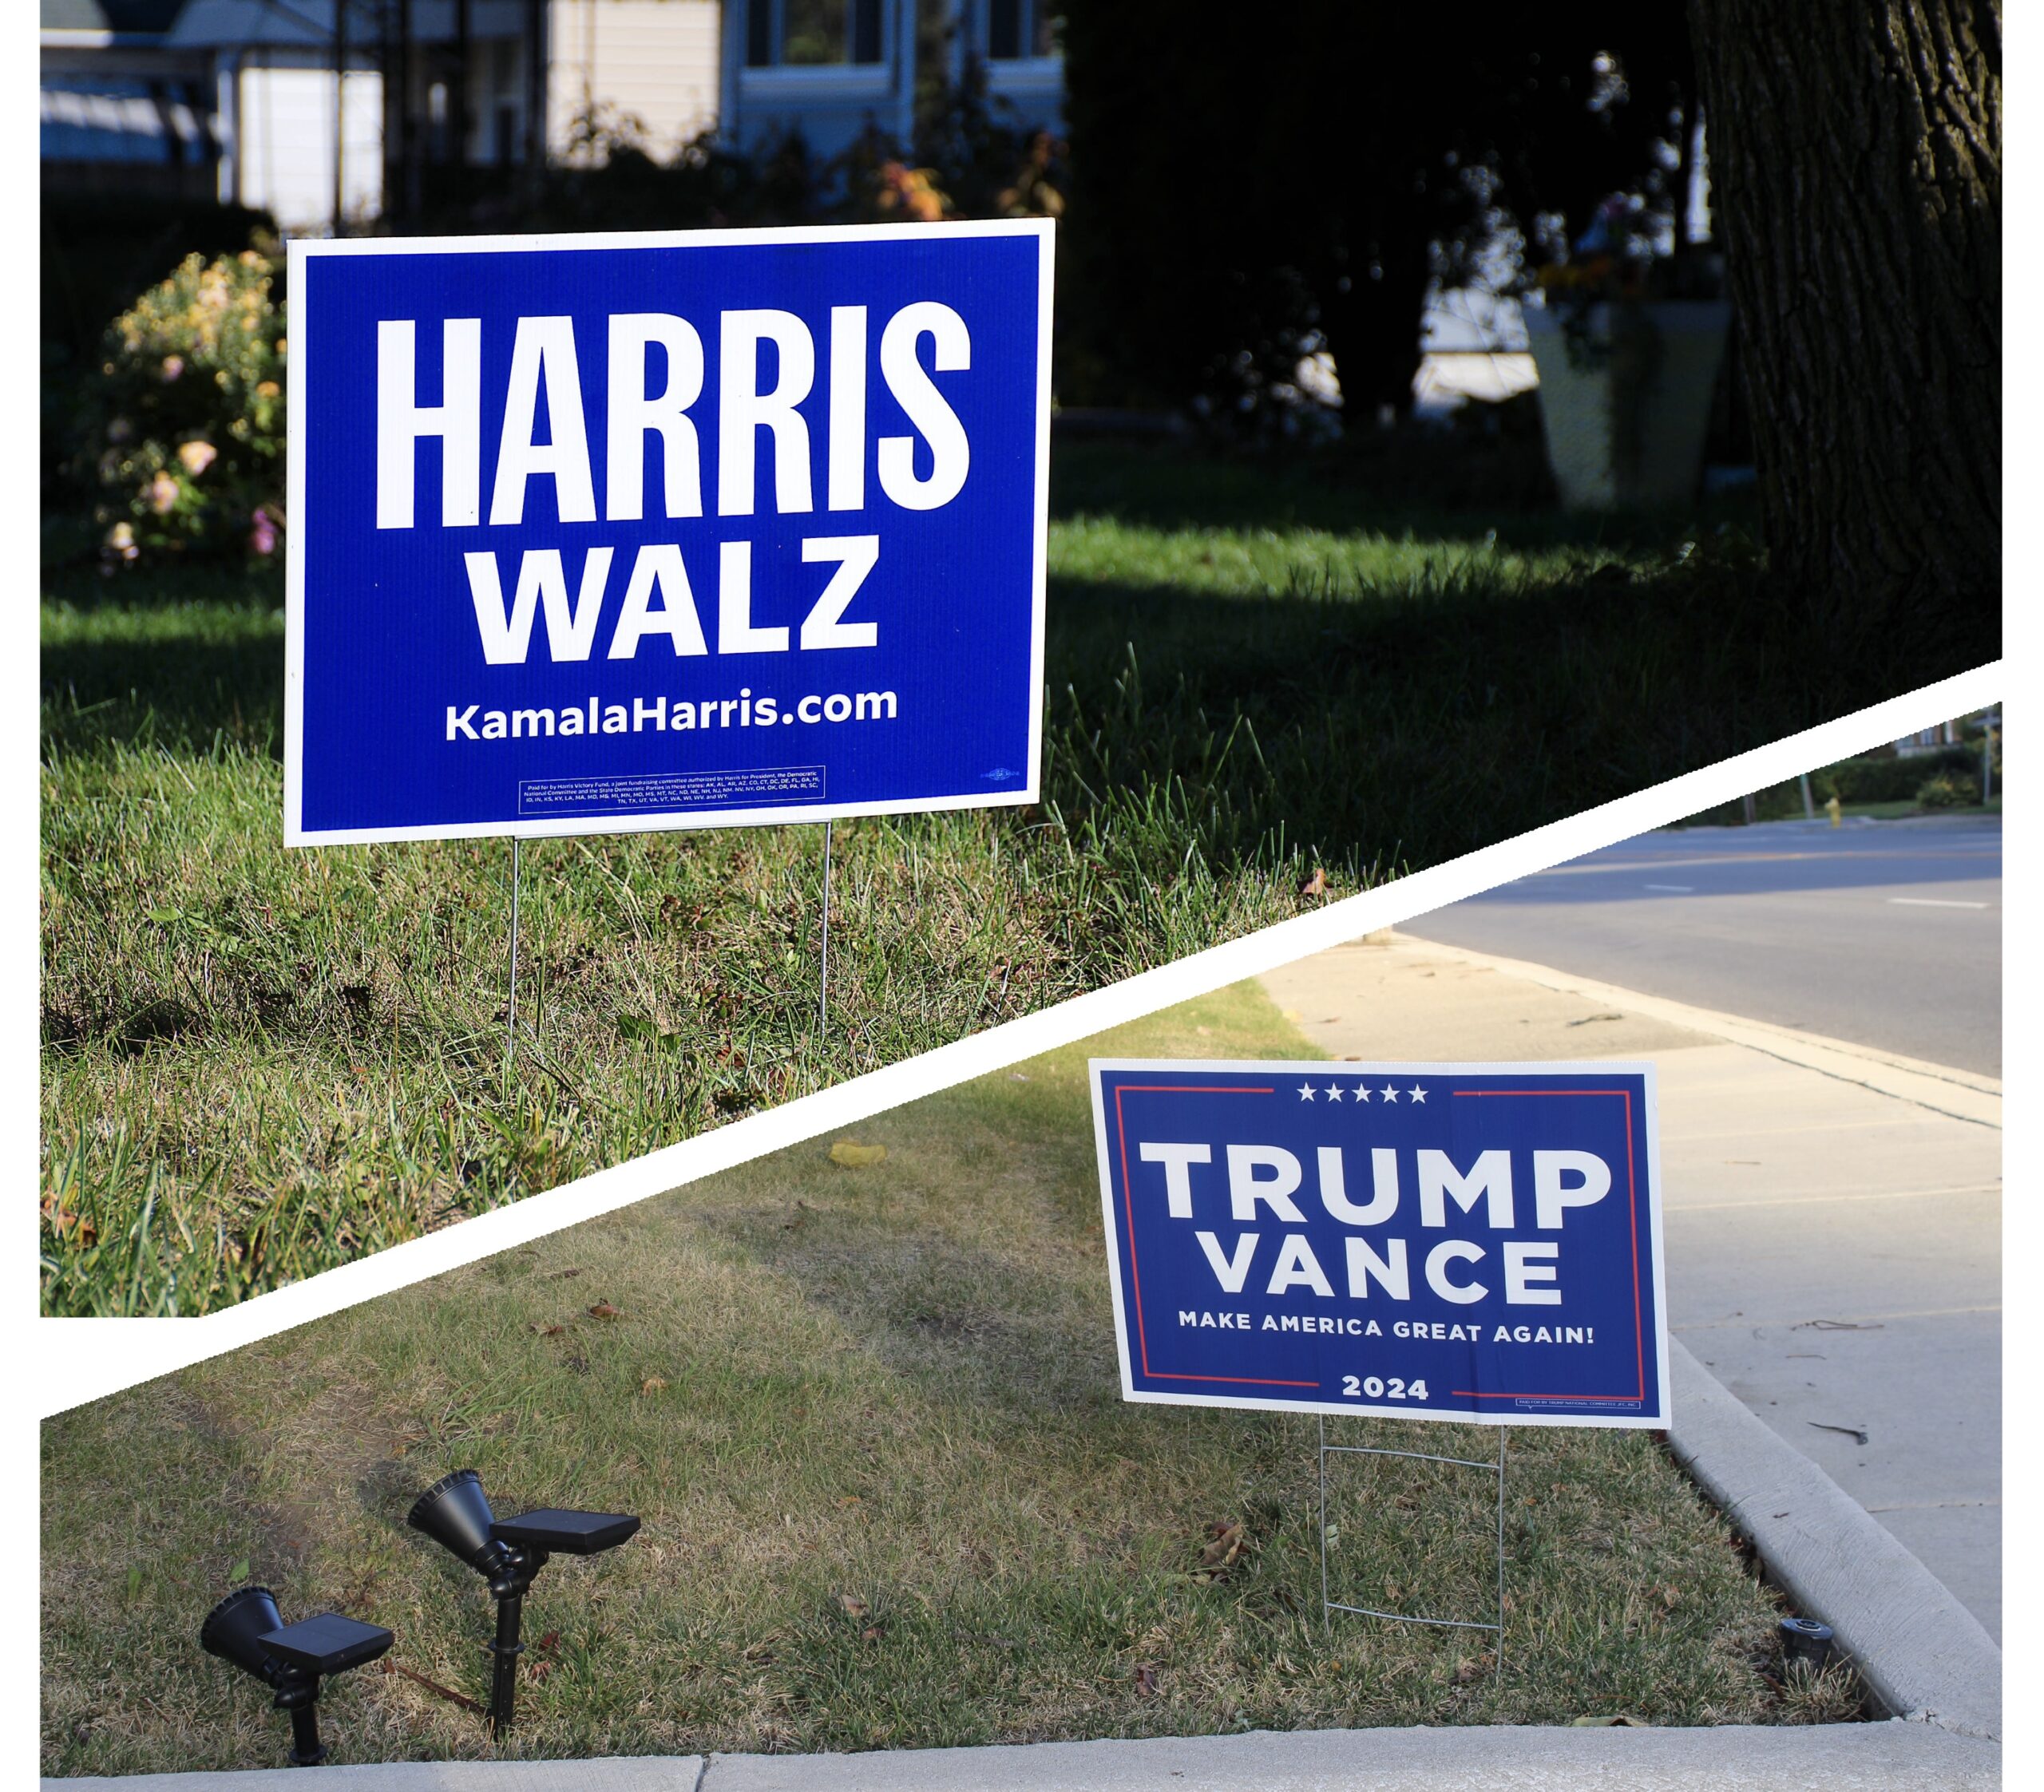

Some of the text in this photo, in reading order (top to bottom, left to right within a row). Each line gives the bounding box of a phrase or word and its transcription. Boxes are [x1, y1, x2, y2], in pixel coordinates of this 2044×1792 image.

[377, 302, 970, 528] HARRIS
[464, 535, 879, 664] WALZ
[446, 688, 897, 741] KamalaHarris.com
[1140, 1142, 1610, 1228] TRUMP
[1195, 1232, 1561, 1304] VANCE
[1179, 1311, 1594, 1344] MAKE AMERICA GREAT AGAIN!
[1342, 1376, 1429, 1400] 2024
